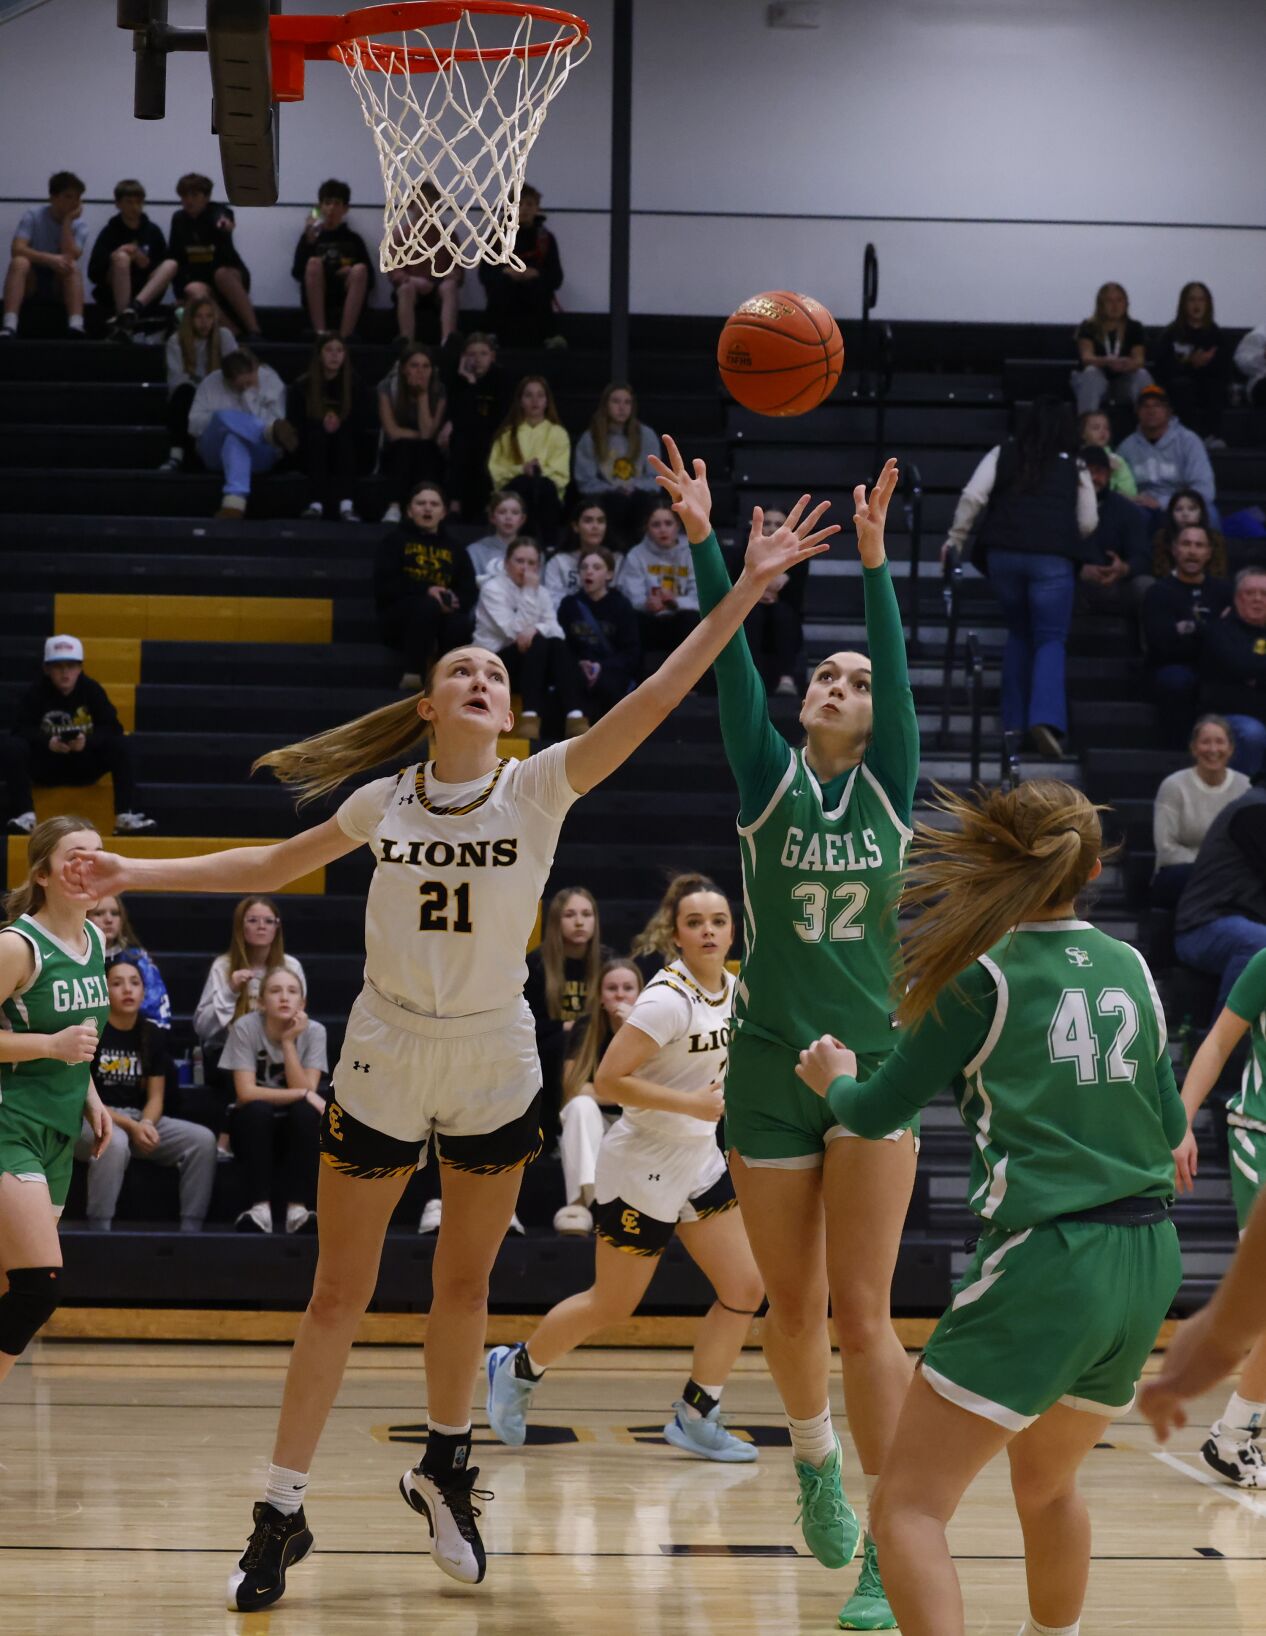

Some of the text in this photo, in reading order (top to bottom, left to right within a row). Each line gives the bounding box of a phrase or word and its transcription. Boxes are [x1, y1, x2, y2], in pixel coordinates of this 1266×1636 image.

[380, 838, 518, 867] LIONS
[781, 826, 883, 871] GAELS
[419, 881, 473, 933] 21
[791, 881, 870, 943] 32
[688, 1027, 729, 1053] LIO
[1047, 988, 1140, 1085] 42
